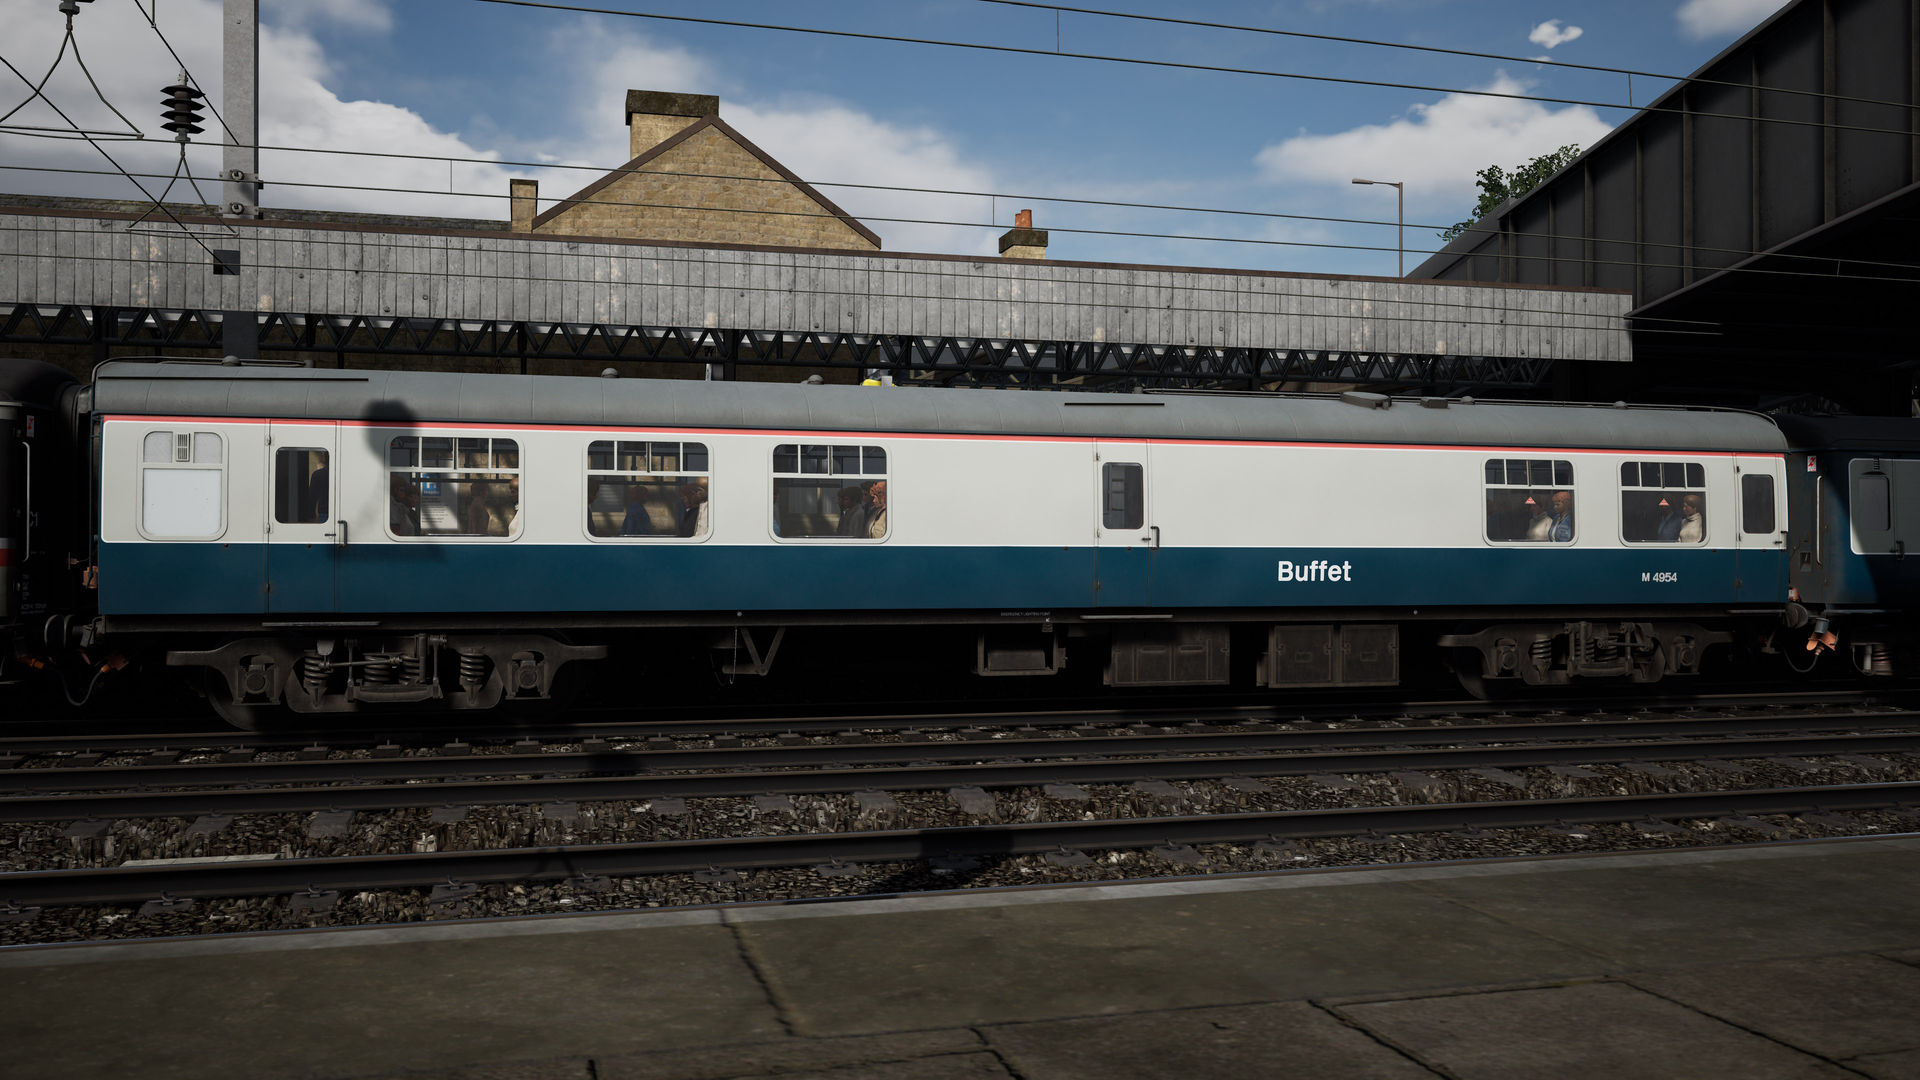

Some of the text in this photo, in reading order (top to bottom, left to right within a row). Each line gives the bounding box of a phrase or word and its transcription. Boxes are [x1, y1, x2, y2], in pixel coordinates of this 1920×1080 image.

[1278, 560, 1352, 582] Buffet
[1641, 572, 1678, 583] M 4954
